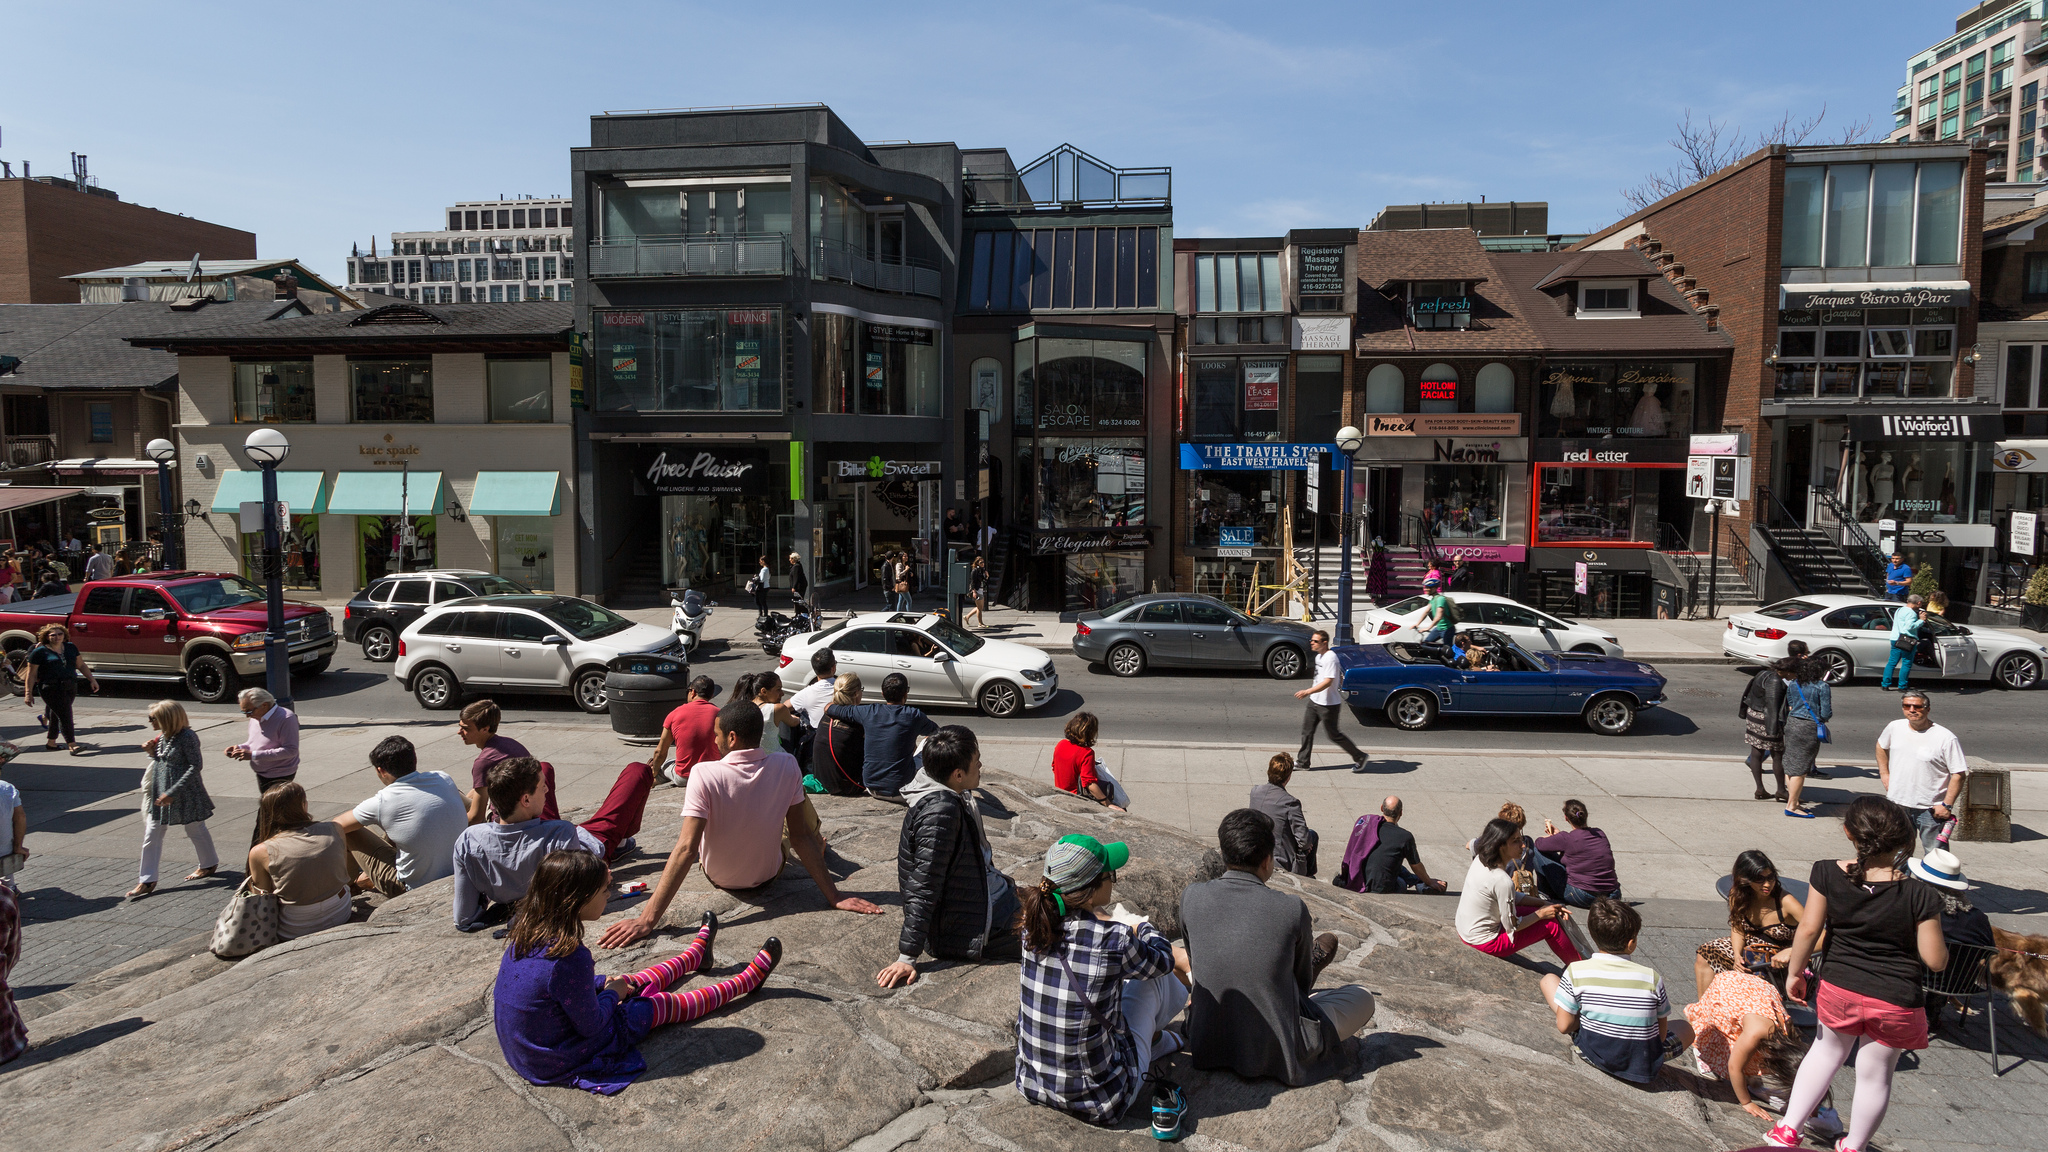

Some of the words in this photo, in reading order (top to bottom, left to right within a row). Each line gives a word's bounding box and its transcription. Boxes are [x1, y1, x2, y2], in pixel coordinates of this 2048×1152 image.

[1301, 247, 1342, 256] Registered
[1304, 256, 1339, 264] Massage
[1305, 264, 1337, 272] Therapy
[1805, 294, 1856, 308] Jacques
[1860, 291, 1900, 305] Bistro
[1902, 292, 1917, 303] du
[1914, 290, 1951, 306] Parc
[1420, 297, 1470, 313] refresh
[603, 316, 645, 324] MODERN
[734, 313, 766, 323] LIVING
[1784, 315, 1812, 324] LIQUOR
[1823, 309, 1861, 323] Jacques
[570, 345, 582, 354] CITY
[738, 356, 758, 368] LEASED
[1201, 362, 1226, 370] LOOKS
[1242, 361, 1285, 369] AESTHETIC
[572, 367, 582, 377] FOR
[1542, 370, 1608, 385] Divine
[1617, 370, 1693, 384] Decadence
[571, 378, 583, 389] RENT
[1420, 382, 1456, 390] HOTLOMI
[1248, 388, 1272, 396] LEASE
[1421, 390, 1454, 399] FACIALS
[1044, 404, 1087, 415] SALON
[1041, 415, 1090, 426] ESCAPE
[1901, 420, 1950, 431] Wolford
[359, 444, 384, 455] kate
[386, 444, 420, 458] spade
[1204, 445, 1231, 457] THE
[1236, 445, 1287, 457] TRAVEL
[1434, 439, 1500, 464] Naomi
[1563, 449, 1629, 462] redLetter
[646, 451, 689, 484] Avec
[687, 451, 753, 478] Plaisir
[1221, 458, 1243, 466] EAST
[1244, 458, 1270, 466] WEST
[1271, 458, 1308, 467] TRAVELS
[837, 460, 866, 477] Bitter
[884, 460, 931, 474] Sweet
[1904, 500, 1930, 509] Wolford
[514, 534, 524, 542] GET
[525, 534, 538, 542] MOM
[1221, 529, 1252, 542] SALE
